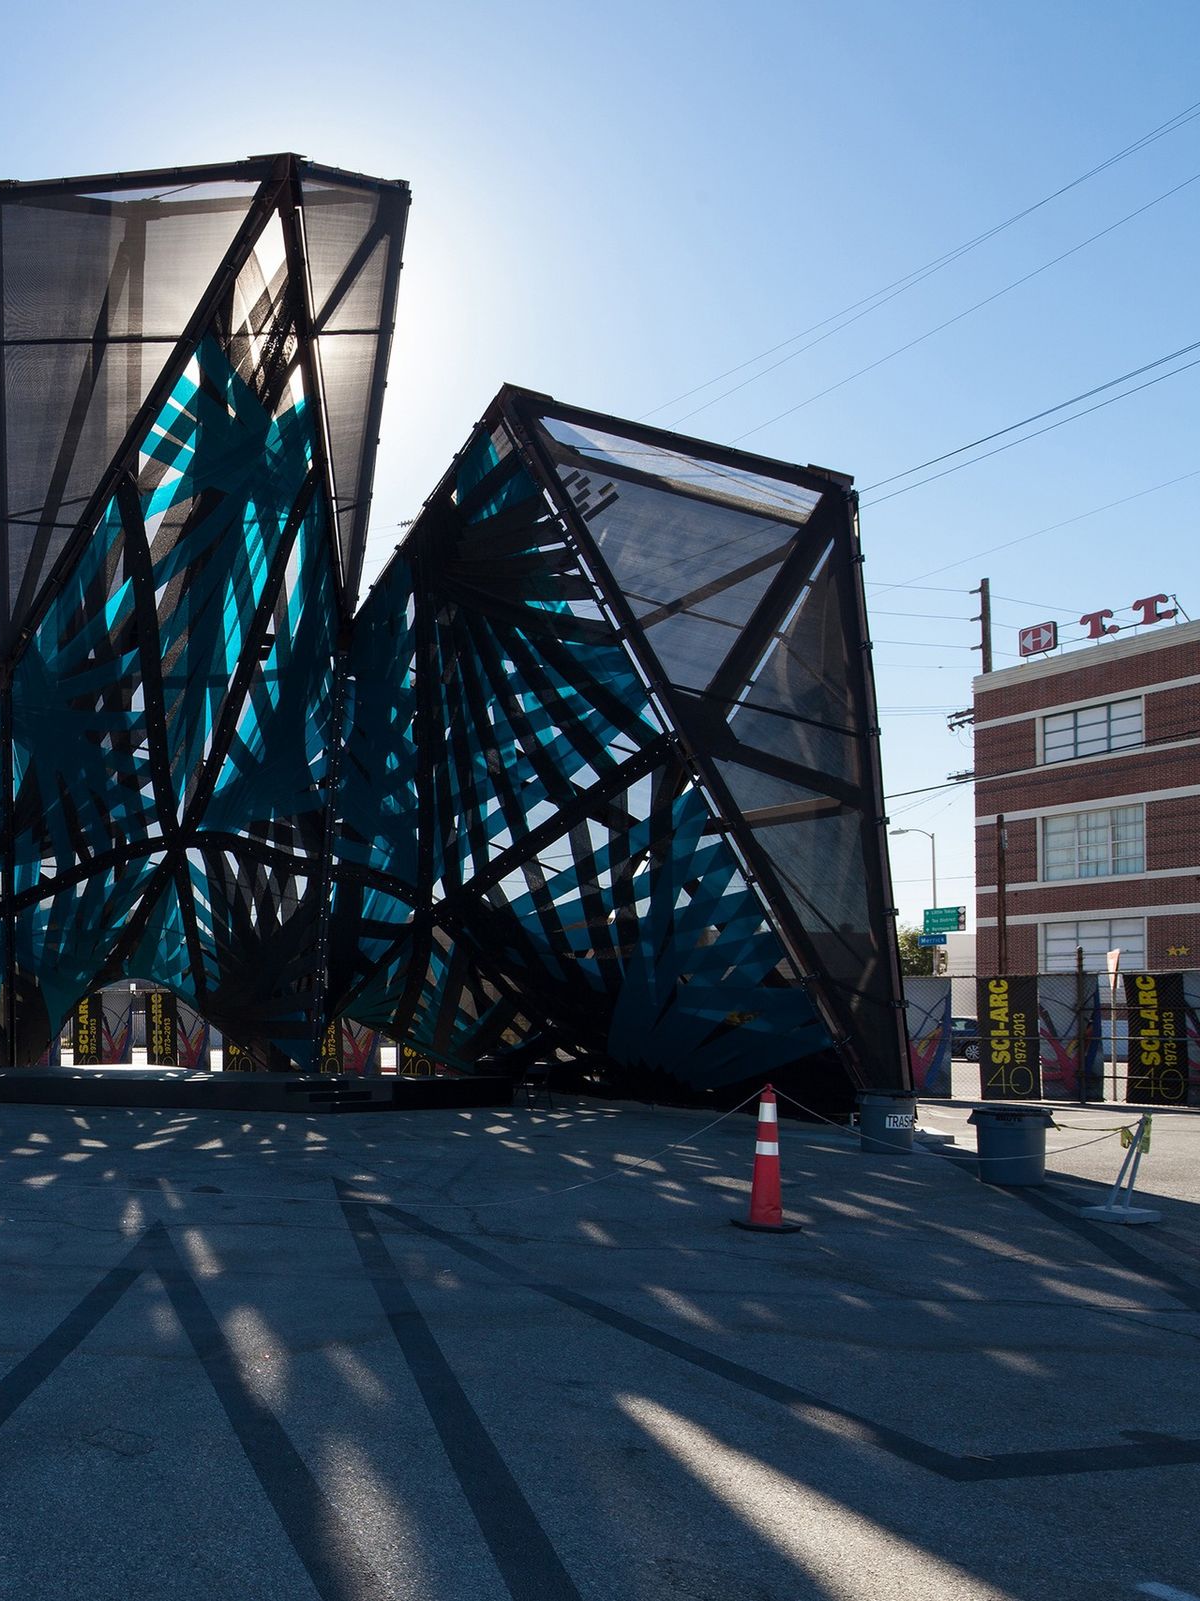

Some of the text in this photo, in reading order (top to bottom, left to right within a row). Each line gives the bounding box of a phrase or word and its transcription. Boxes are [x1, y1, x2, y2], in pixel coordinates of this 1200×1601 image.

[988, 979, 1011, 1064] SCI-ARC
[1013, 1012, 1027, 1065] 1973-2013
[1135, 975, 1161, 1066] SCI-ARC
[1162, 1011, 1178, 1067] 1973-2013
[987, 1065, 1034, 1095] 40
[1134, 1067, 1184, 1099] 40
